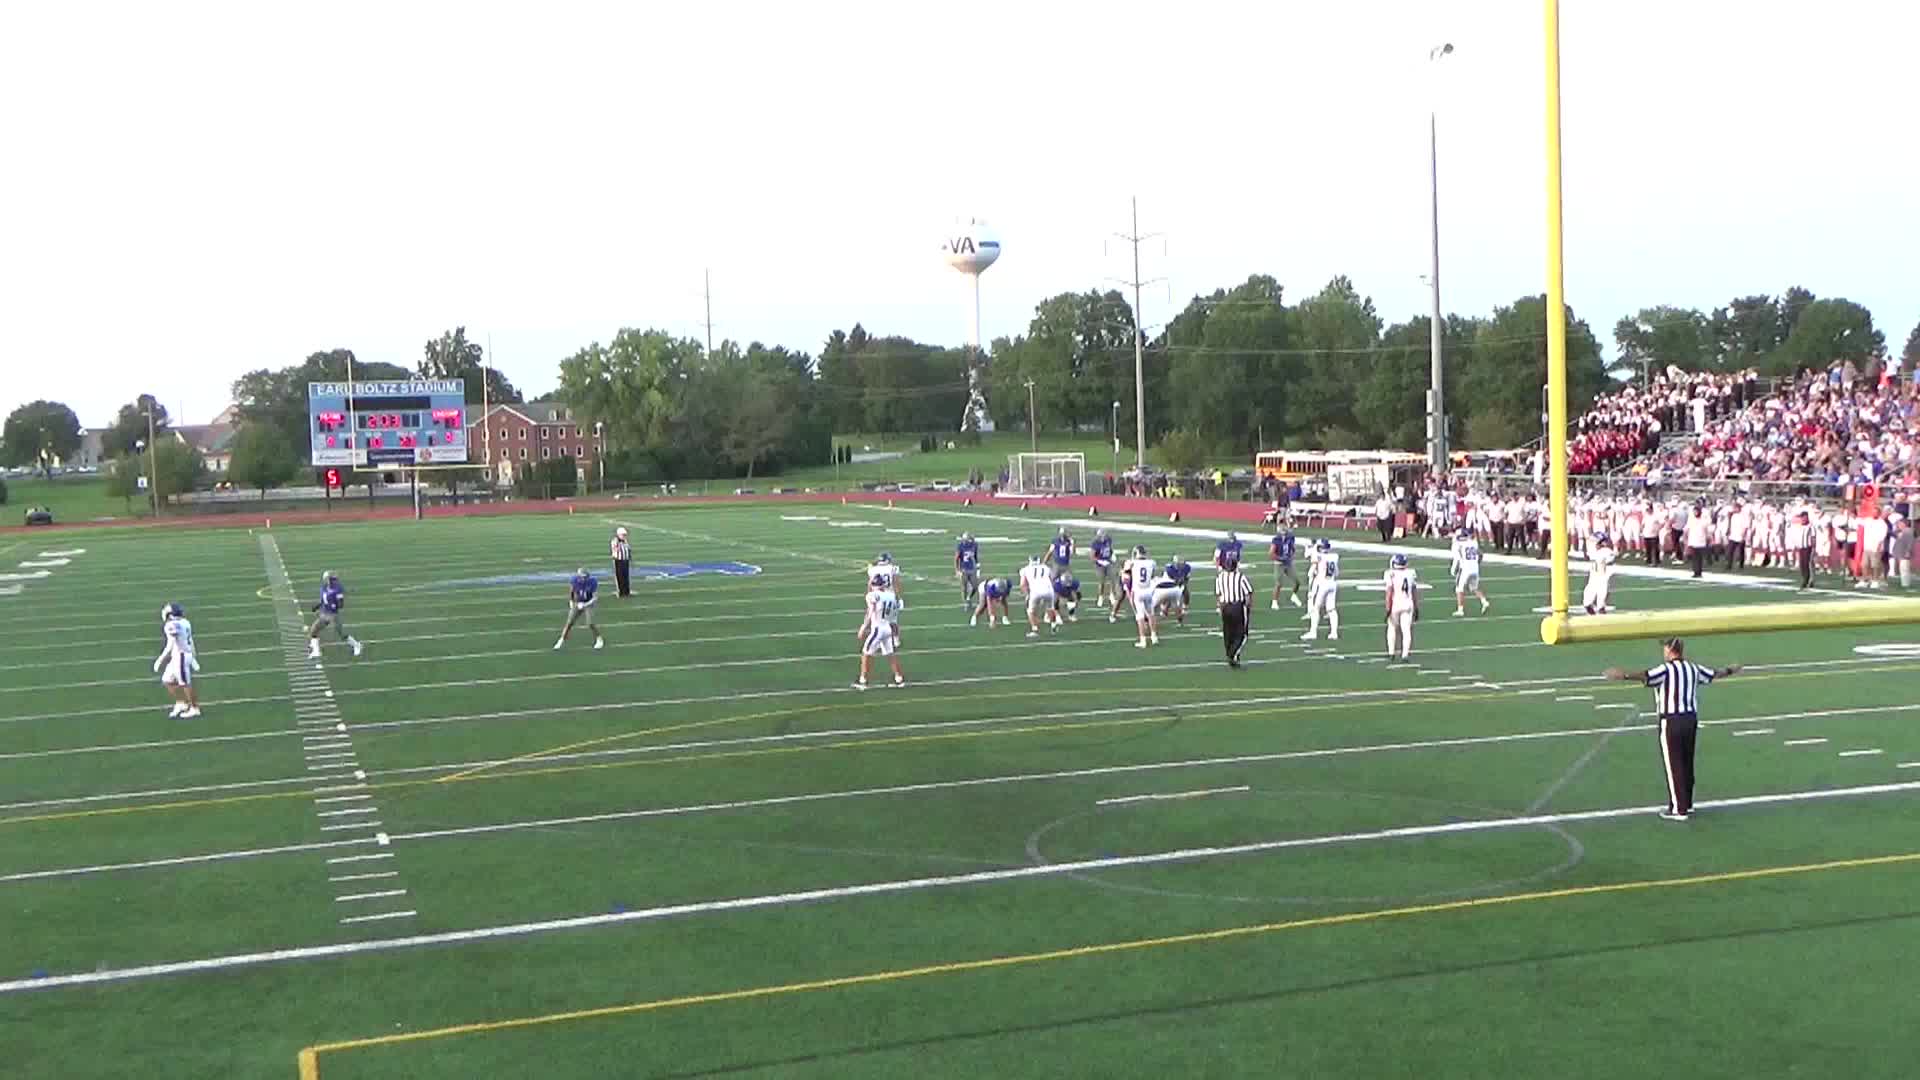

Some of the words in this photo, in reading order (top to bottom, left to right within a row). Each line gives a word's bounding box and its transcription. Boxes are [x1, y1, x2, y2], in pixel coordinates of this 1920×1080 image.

[950, 236, 976, 254] VA
[316, 384, 350, 395] EARL
[355, 383, 397, 394] BOLTZ
[399, 381, 457, 393] STADIUM
[1139, 567, 1148, 583] 9
[1401, 577, 1409, 594] 4
